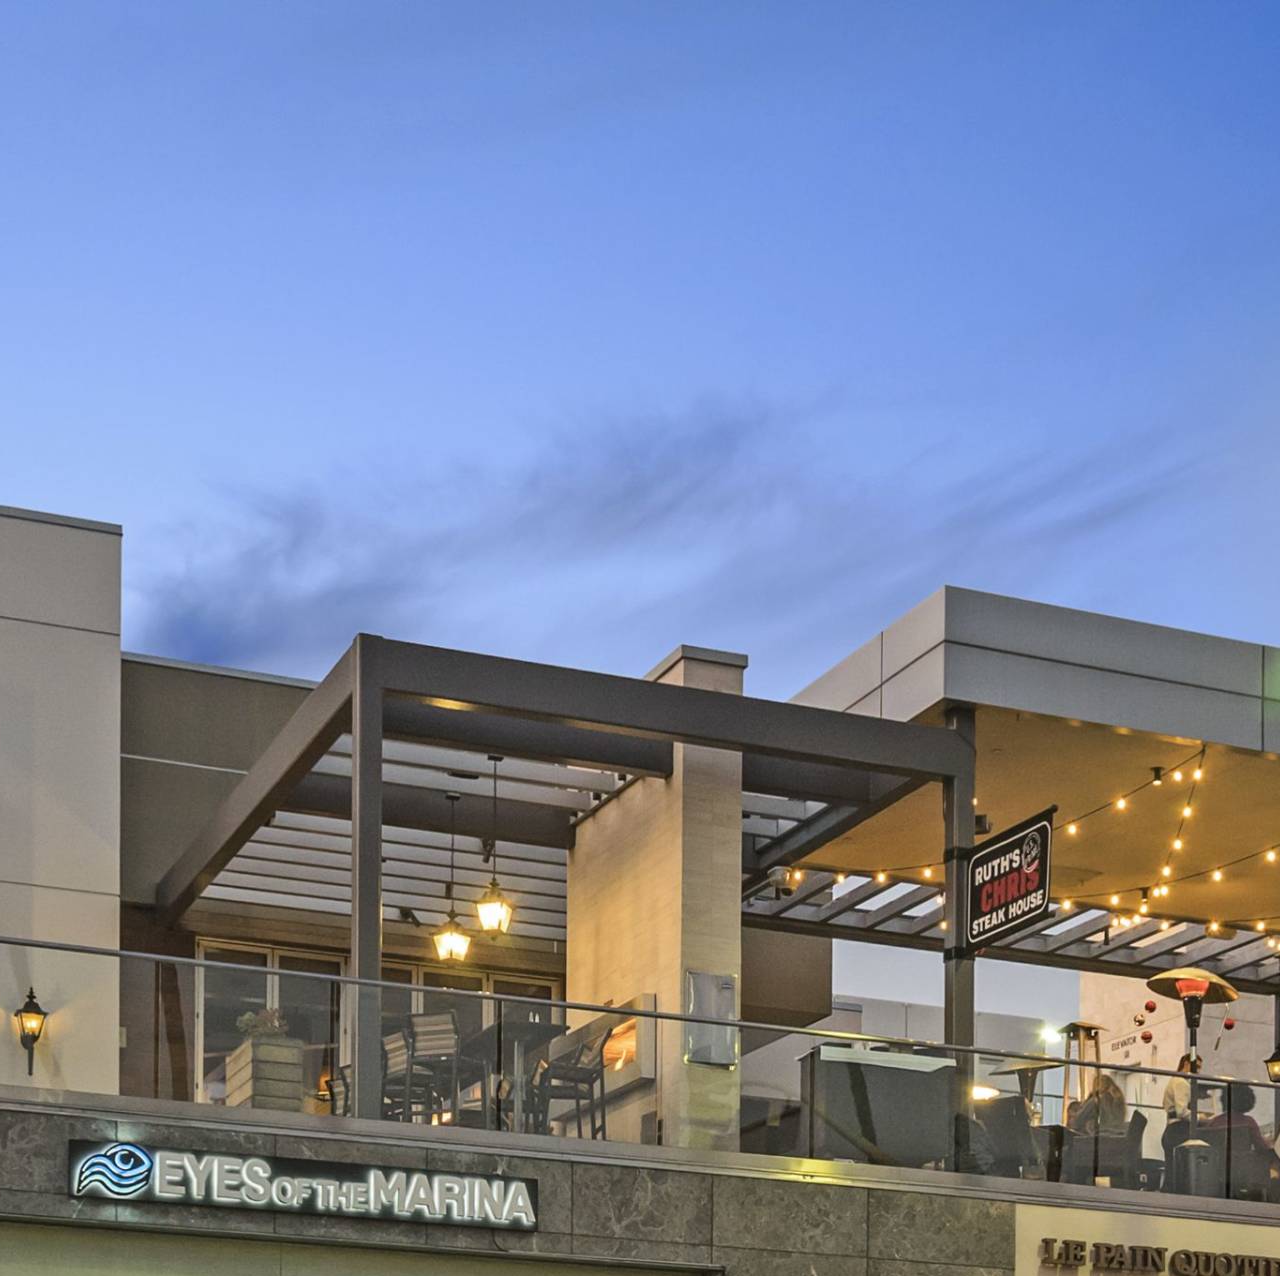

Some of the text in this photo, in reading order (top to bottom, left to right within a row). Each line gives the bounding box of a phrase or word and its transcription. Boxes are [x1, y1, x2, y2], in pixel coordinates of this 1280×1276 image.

[974, 848, 1021, 887] RUTH'S
[980, 865, 1040, 913] CHRIS
[972, 889, 1044, 936] STEAK HOUSE
[155, 1151, 537, 1225] EYES OF THE MARINA
[1039, 1238, 1086, 1267] LE
[1091, 1242, 1168, 1272] PAIN
